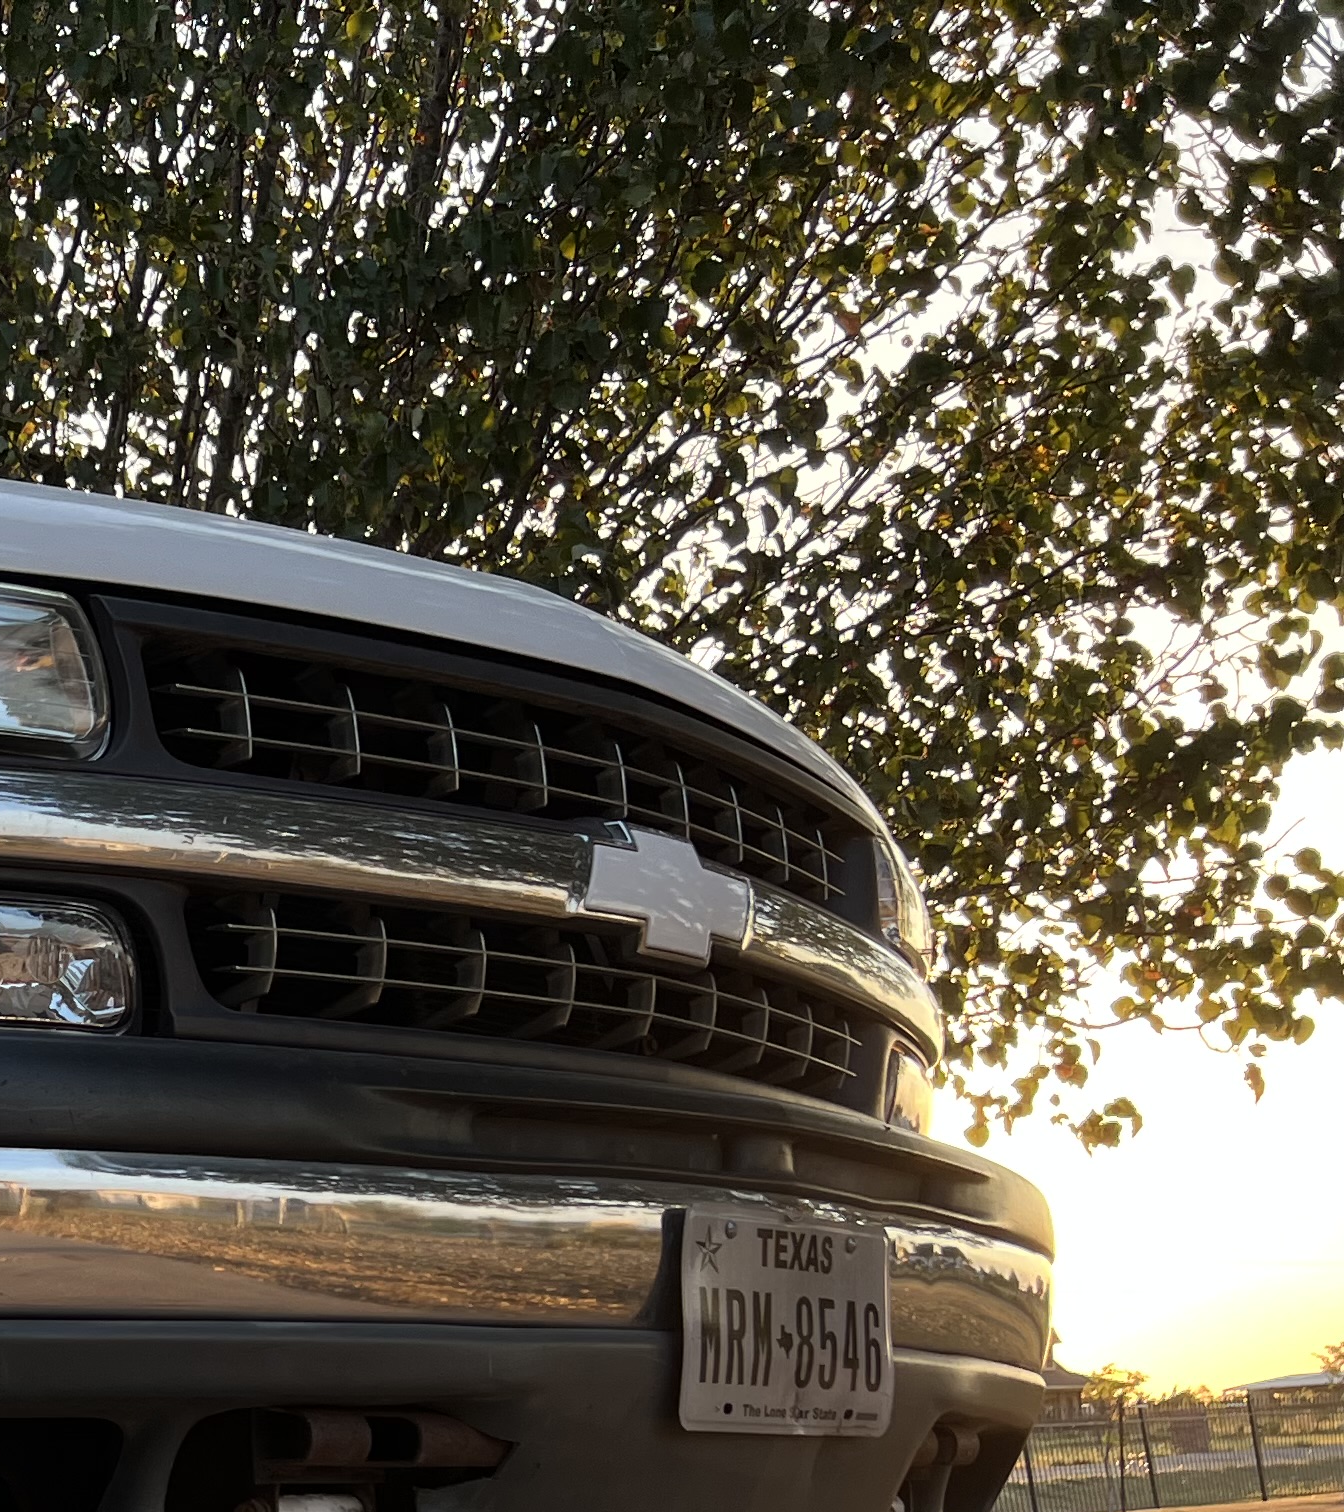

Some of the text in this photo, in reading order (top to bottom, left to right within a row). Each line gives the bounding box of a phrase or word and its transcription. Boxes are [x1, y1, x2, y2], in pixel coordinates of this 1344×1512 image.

[757, 1227, 833, 1275] TEXAS
[698, 1286, 882, 1392] MRM 8546
[742, 1403, 761, 1418] The
[764, 1405, 787, 1419] Lone
[812, 1407, 837, 1421] State
